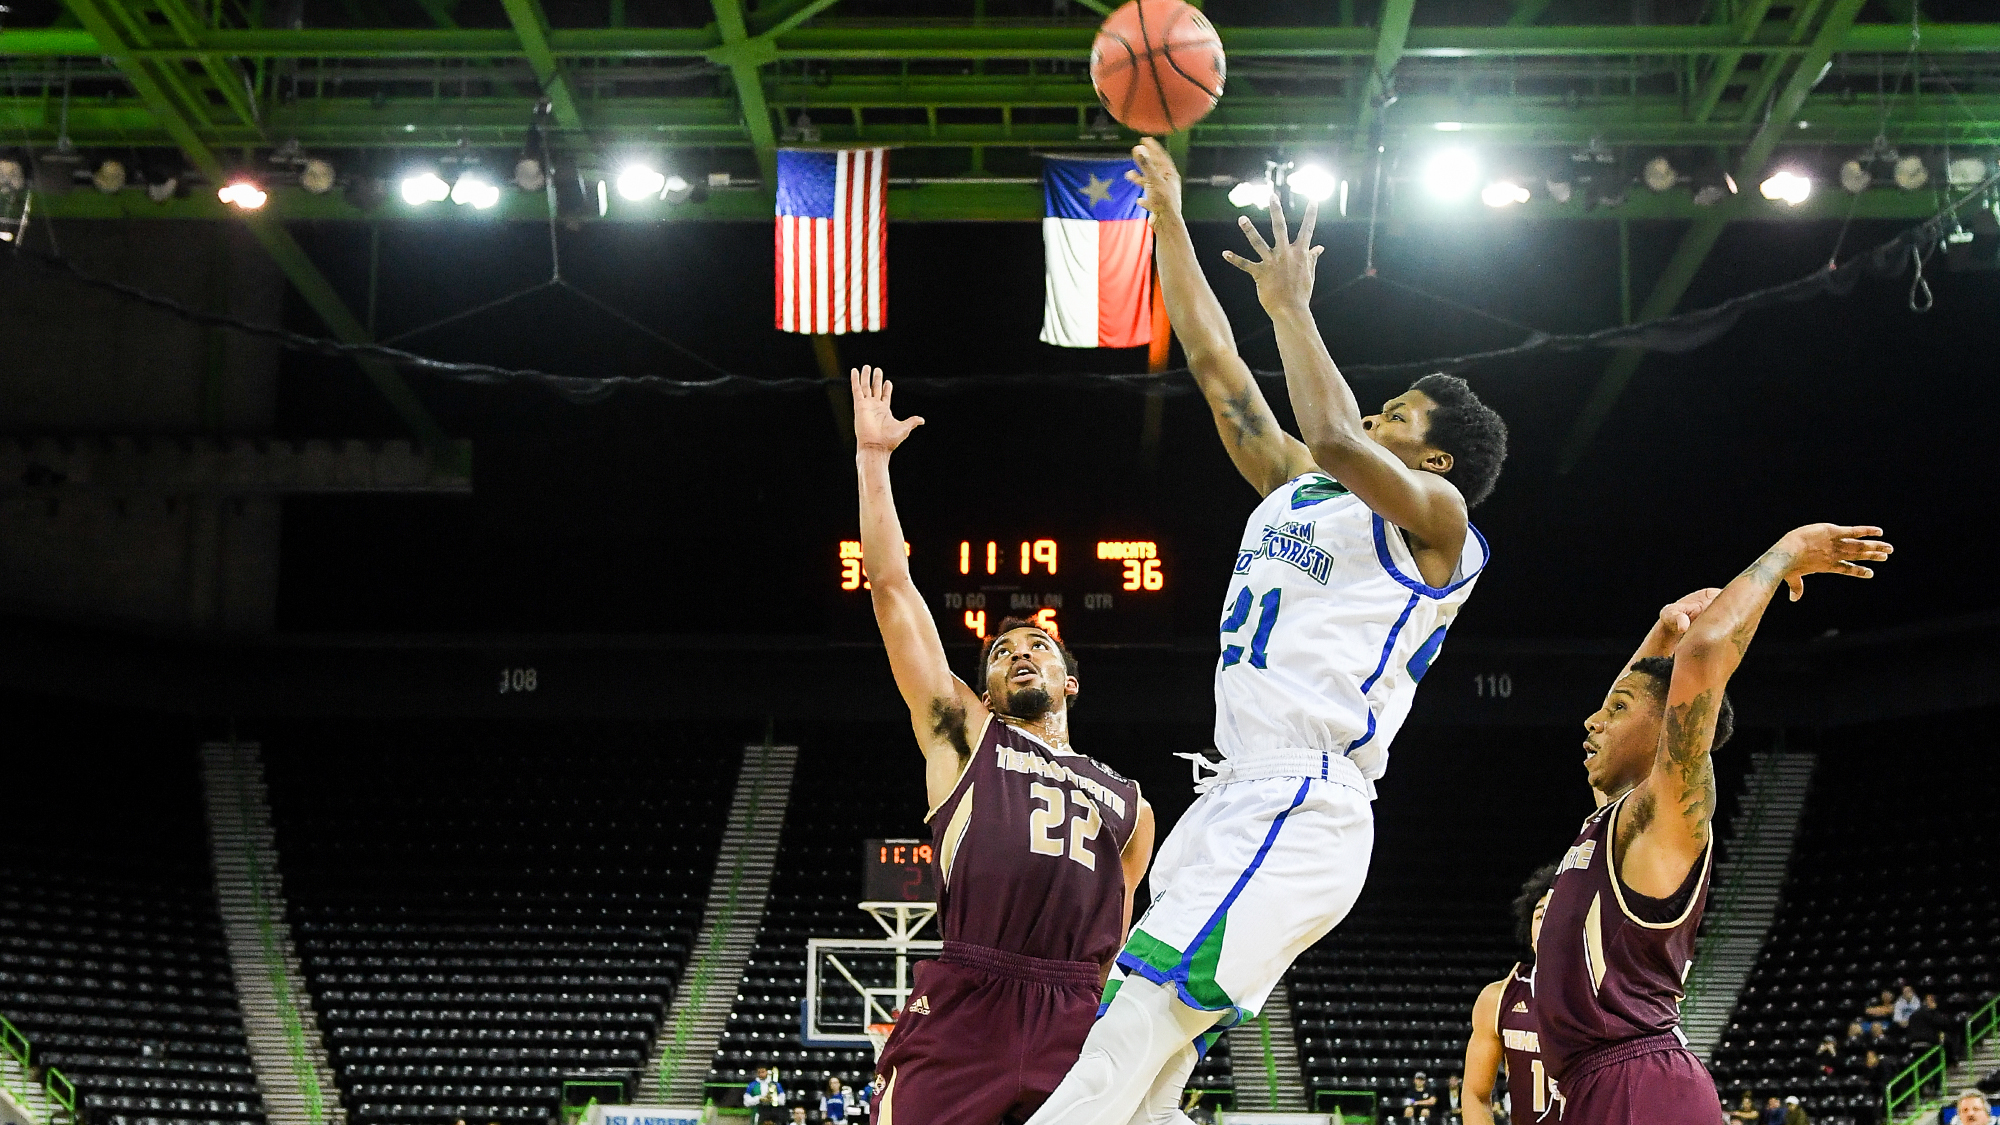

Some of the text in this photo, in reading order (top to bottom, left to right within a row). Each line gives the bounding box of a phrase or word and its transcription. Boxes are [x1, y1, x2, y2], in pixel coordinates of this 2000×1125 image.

[841, 558, 872, 590] 3
[1122, 558, 1163, 591] 36
[1267, 535, 1332, 583] CHRISTI
[944, 593, 986, 609] TO GO
[1084, 593, 1113, 610] QTR
[964, 609, 986, 639] 4
[1220, 585, 1282, 671] 21
[500, 668, 537, 692] 108
[1474, 673, 1512, 698] 110
[995, 743, 1067, 782] TEXAS
[1029, 781, 1103, 872] 22
[880, 844, 933, 864] 11:19
[902, 866, 922, 900] 2
